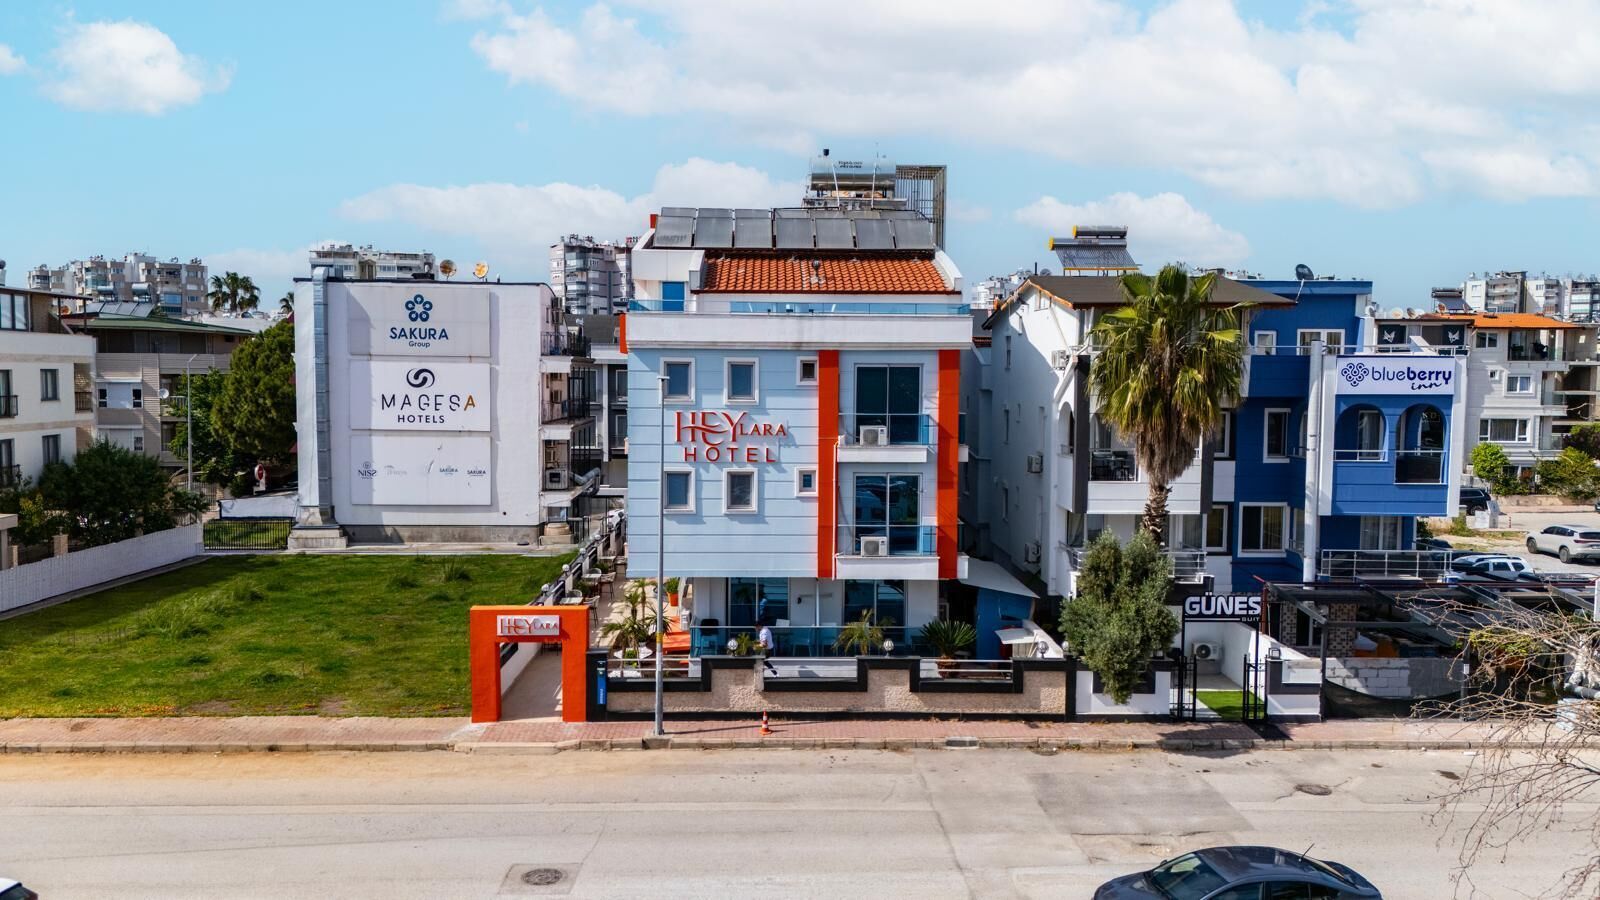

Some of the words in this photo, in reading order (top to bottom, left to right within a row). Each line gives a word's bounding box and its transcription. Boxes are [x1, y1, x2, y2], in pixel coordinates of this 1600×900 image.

[389, 327, 449, 340] SAKURA
[408, 340, 431, 348] Group
[1371, 366, 1452, 385] blueberry
[1410, 382, 1442, 391] inn
[381, 393, 476, 412] MAGESA
[397, 414, 445, 424] HOTELS
[684, 446, 777, 463] HOTEL
